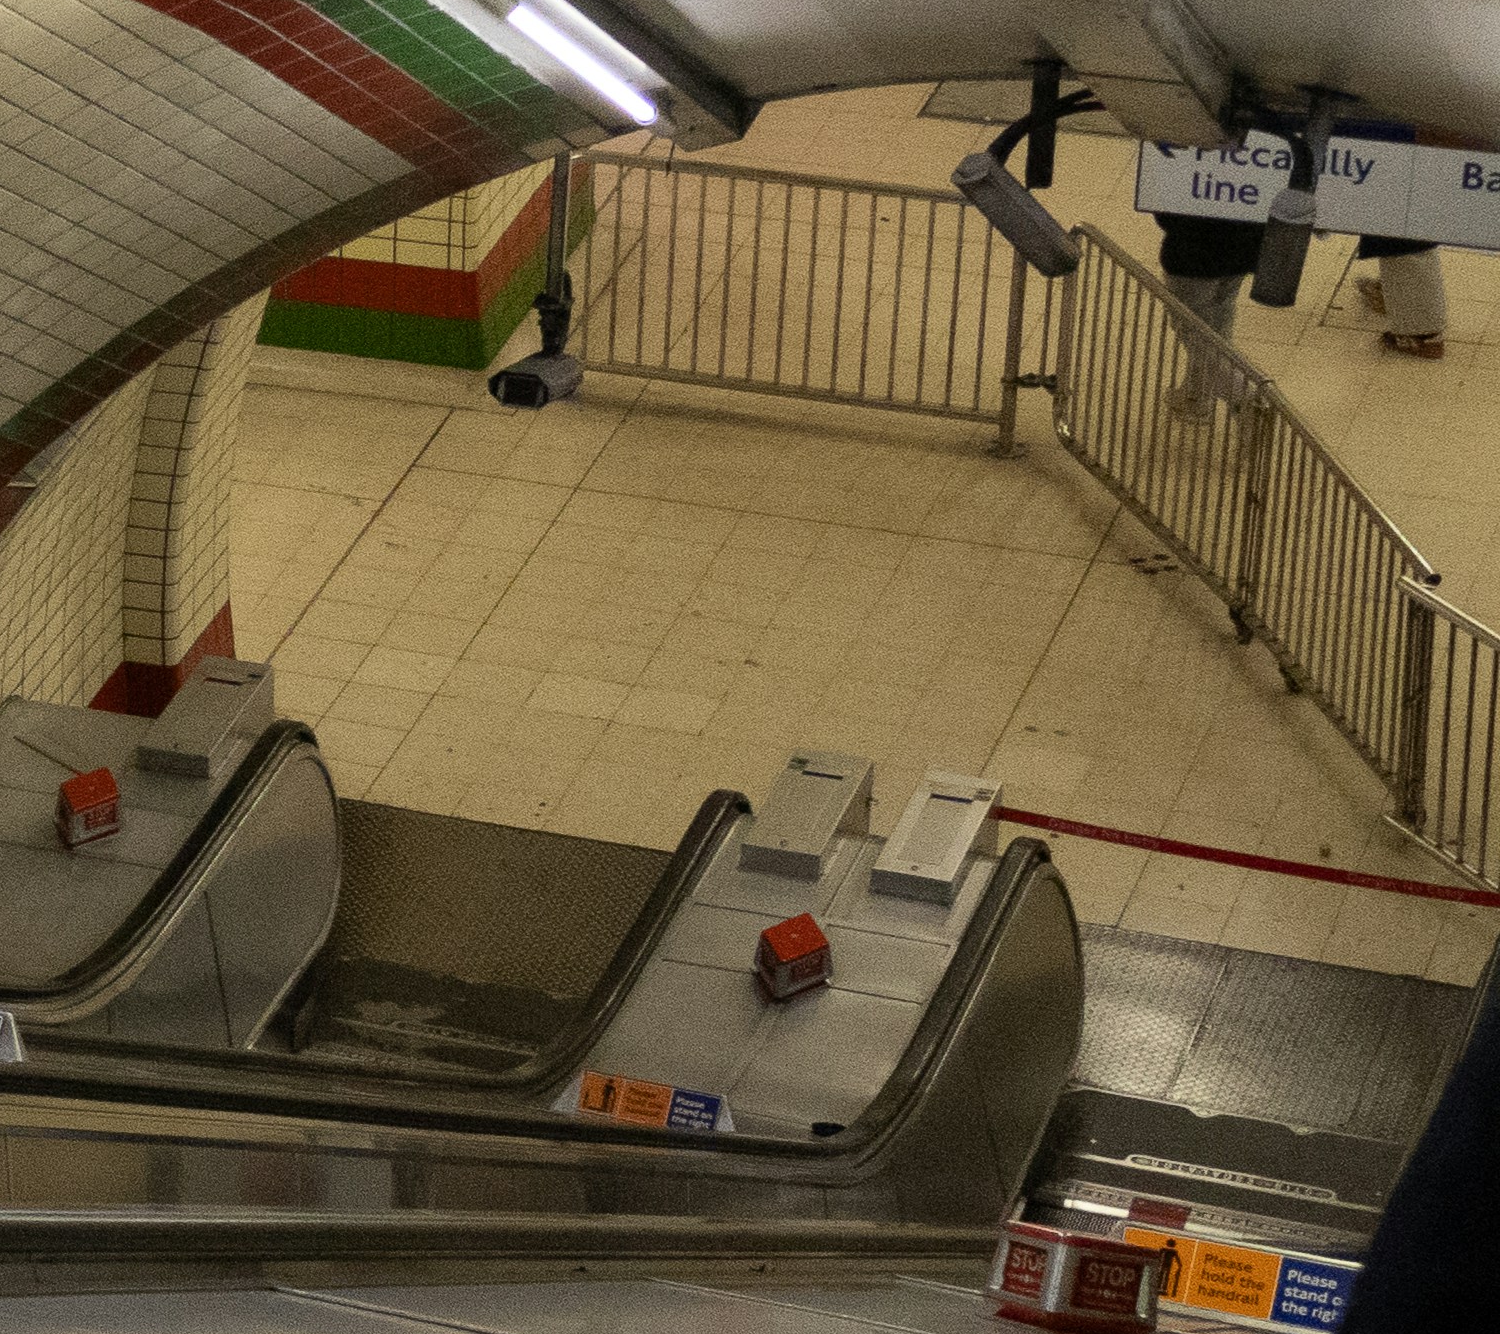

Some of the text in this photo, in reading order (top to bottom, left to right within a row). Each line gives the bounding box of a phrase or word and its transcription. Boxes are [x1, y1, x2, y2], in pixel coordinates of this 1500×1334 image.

[1190, 171, 1259, 206] line
[1203, 1251, 1253, 1274] Please
[1086, 1263, 1136, 1289] STOP
[1200, 1265, 1265, 1291] hold the
[1287, 1269, 1338, 1290] Please
[1197, 1282, 1259, 1307] handrail
[1283, 1284, 1328, 1304] stand
[1281, 1299, 1307, 1316] the
